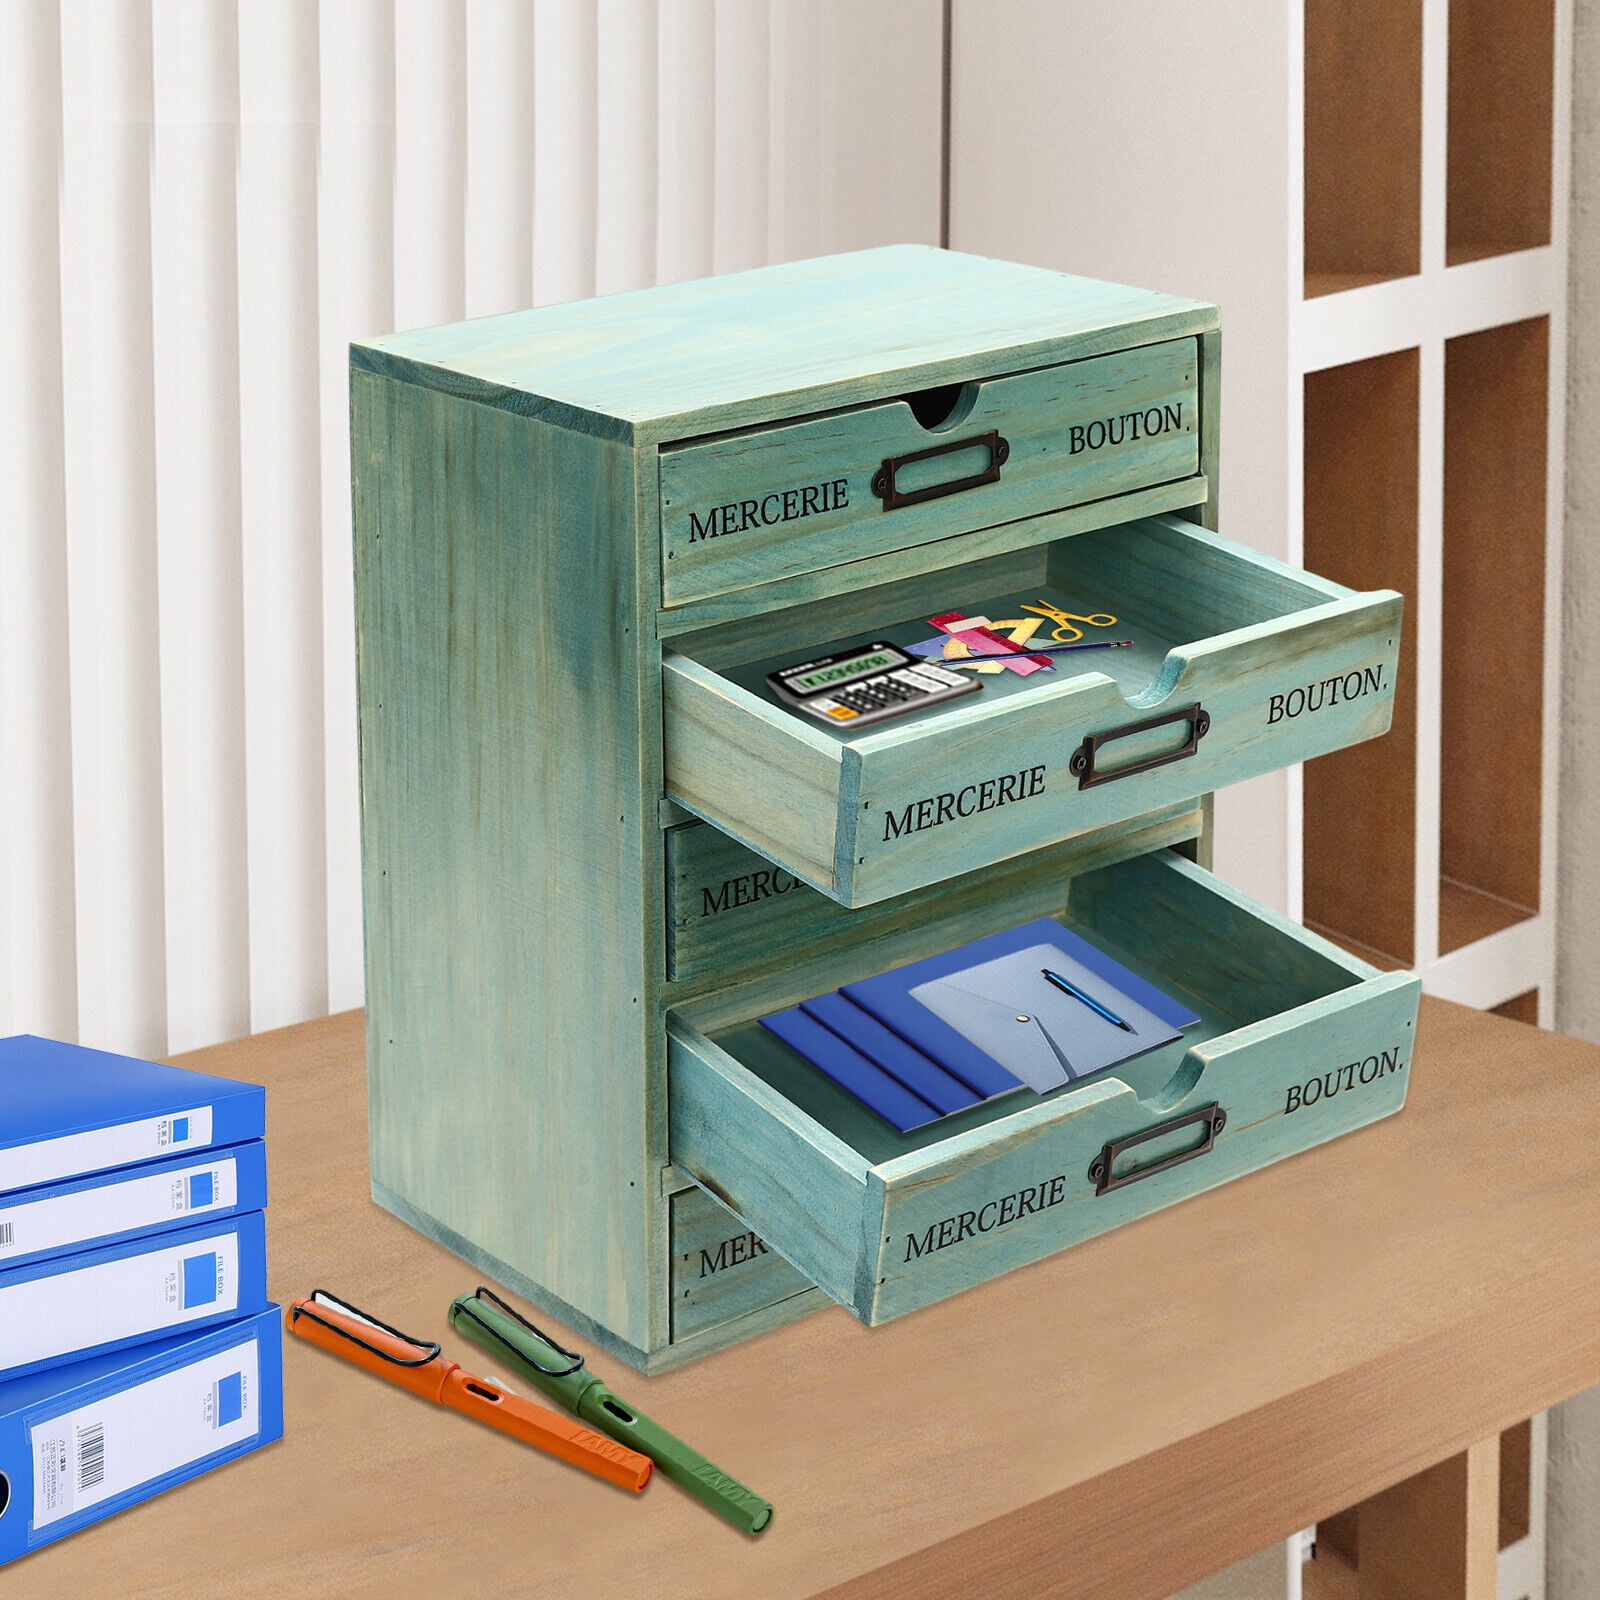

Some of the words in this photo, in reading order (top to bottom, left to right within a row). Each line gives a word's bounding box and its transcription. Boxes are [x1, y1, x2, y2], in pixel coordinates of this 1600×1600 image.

[688, 478, 849, 543] MERCERIE
[882, 764, 1047, 842] MERCERIE
[903, 1175, 1066, 1263] MERCERIE
